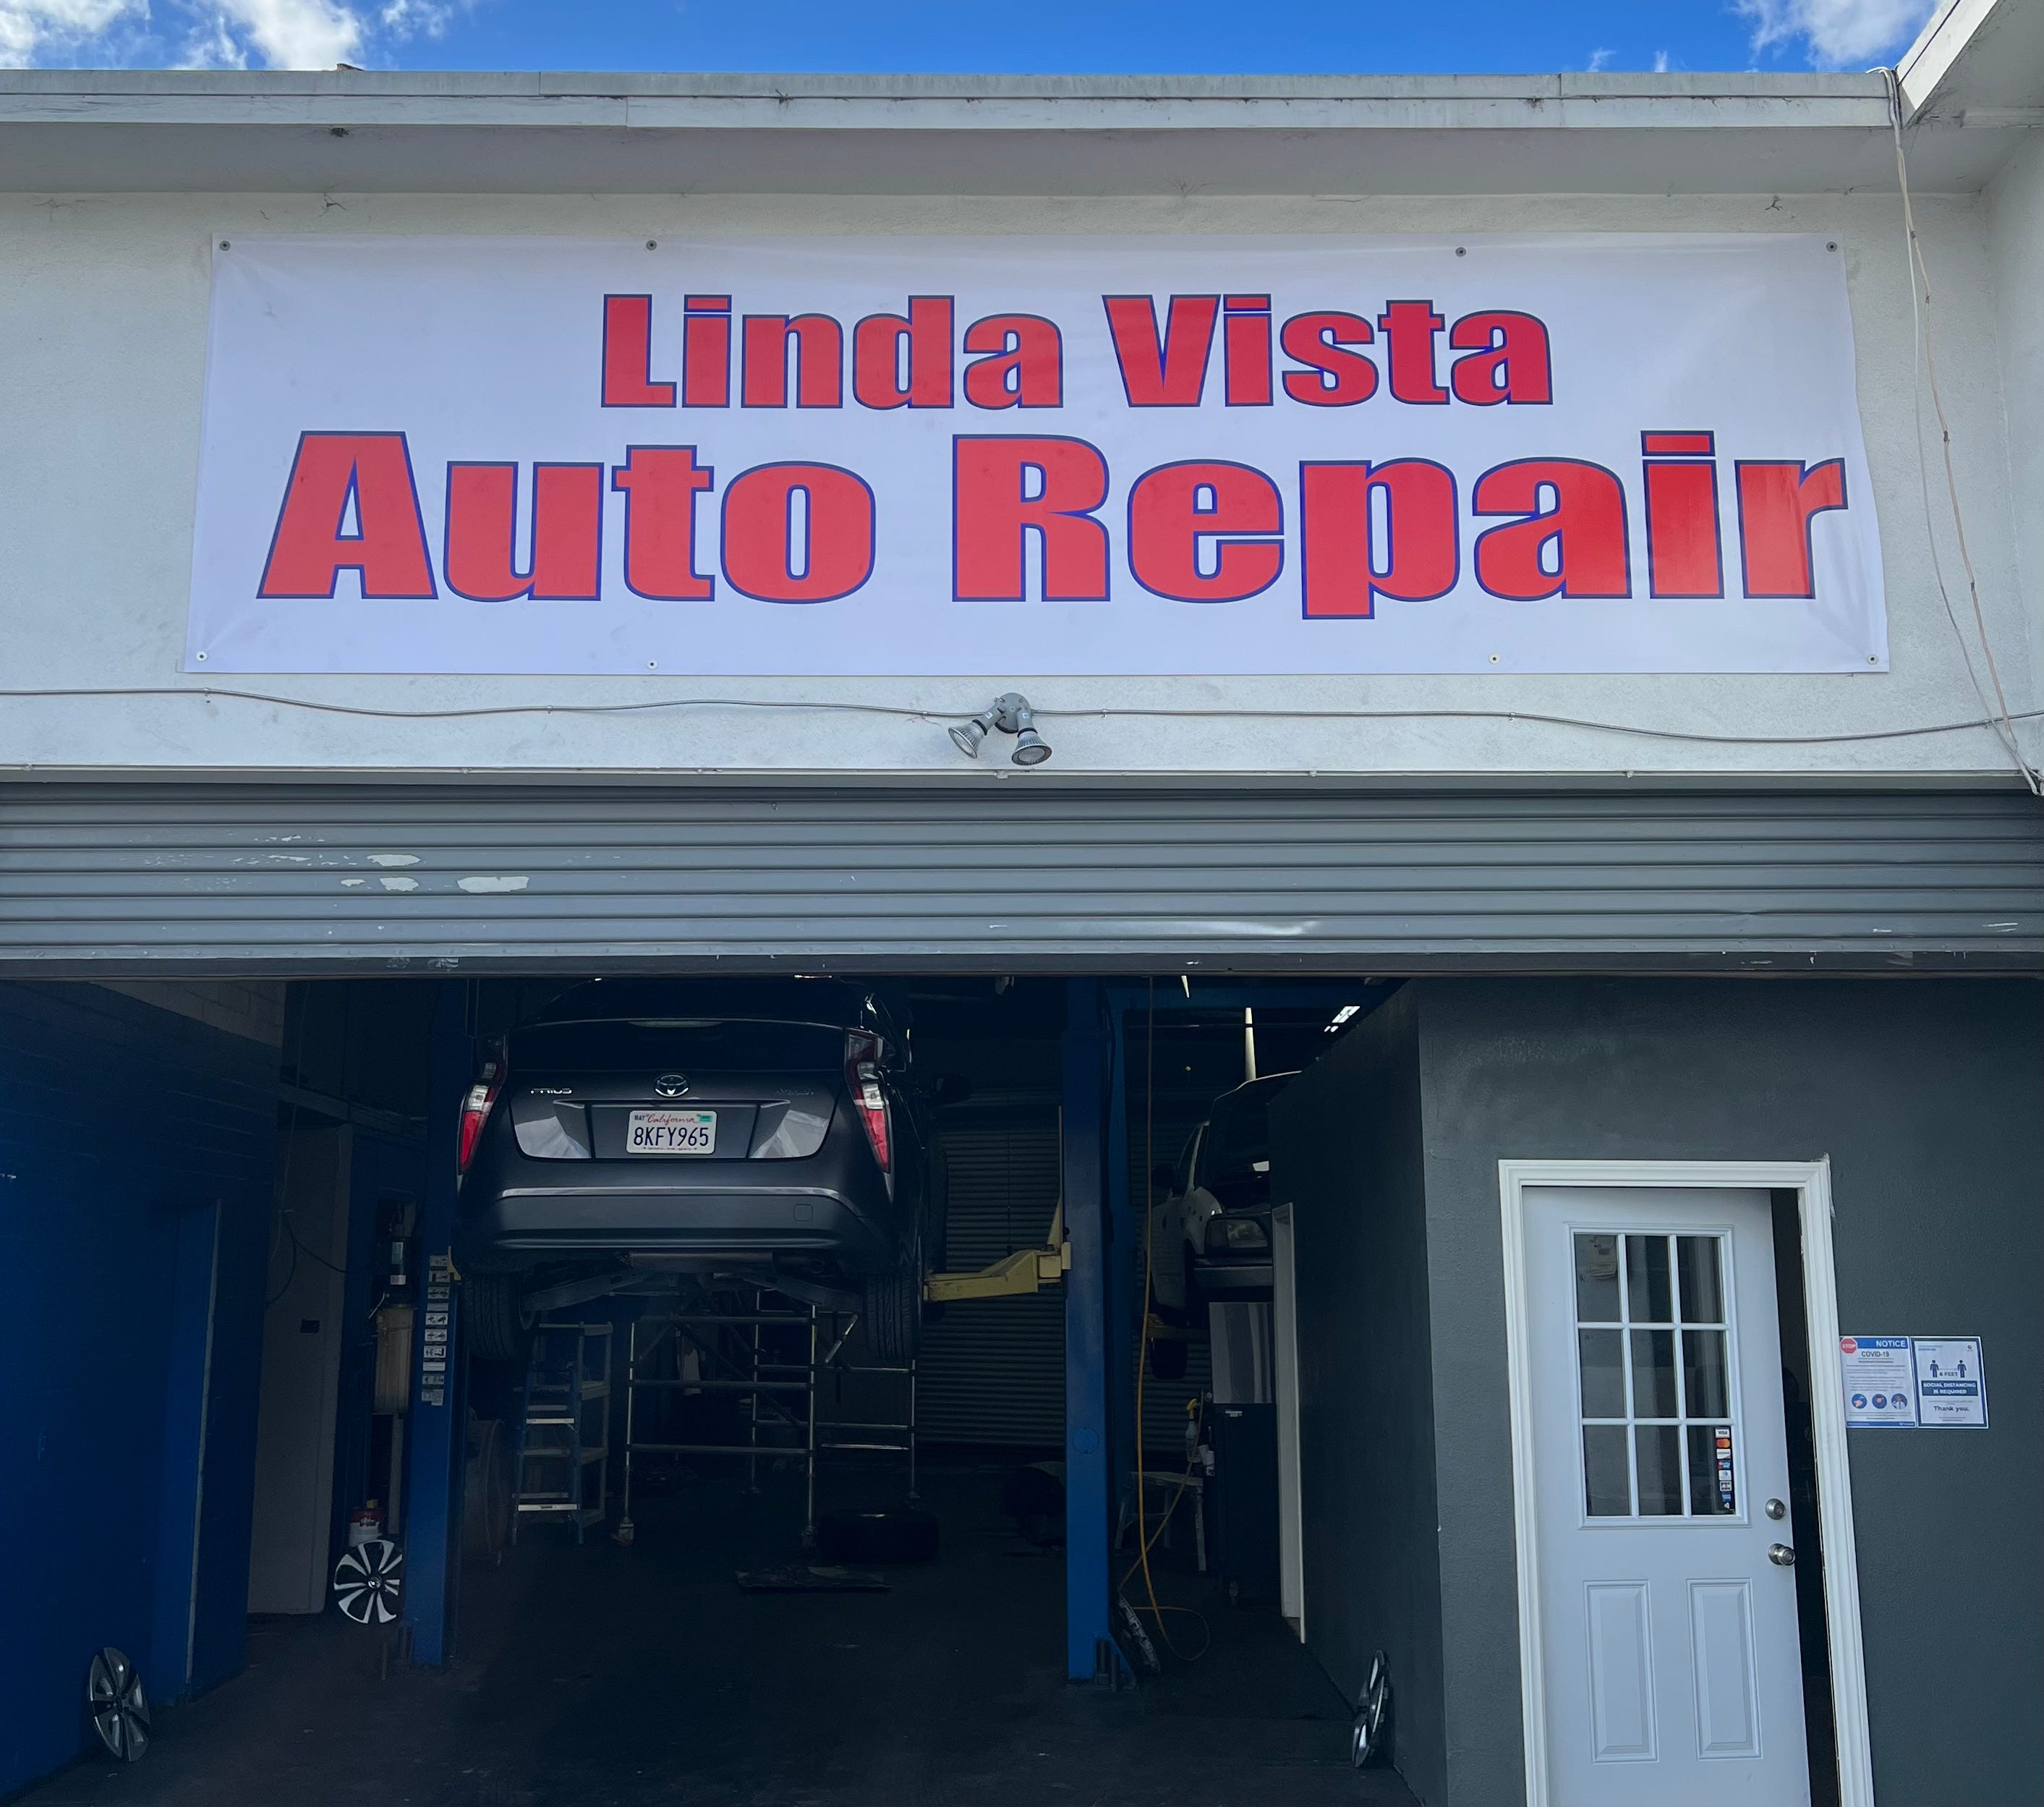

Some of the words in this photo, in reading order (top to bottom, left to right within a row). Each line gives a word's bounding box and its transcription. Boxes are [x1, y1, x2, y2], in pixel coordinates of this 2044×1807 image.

[601, 294, 1064, 409] Linda
[1102, 293, 1553, 407] Vista
[256, 431, 876, 604] Auto
[953, 430, 1849, 619] Repair
[634, 1127, 709, 1147] 8KFY965
[647, 1114, 699, 1126] California
